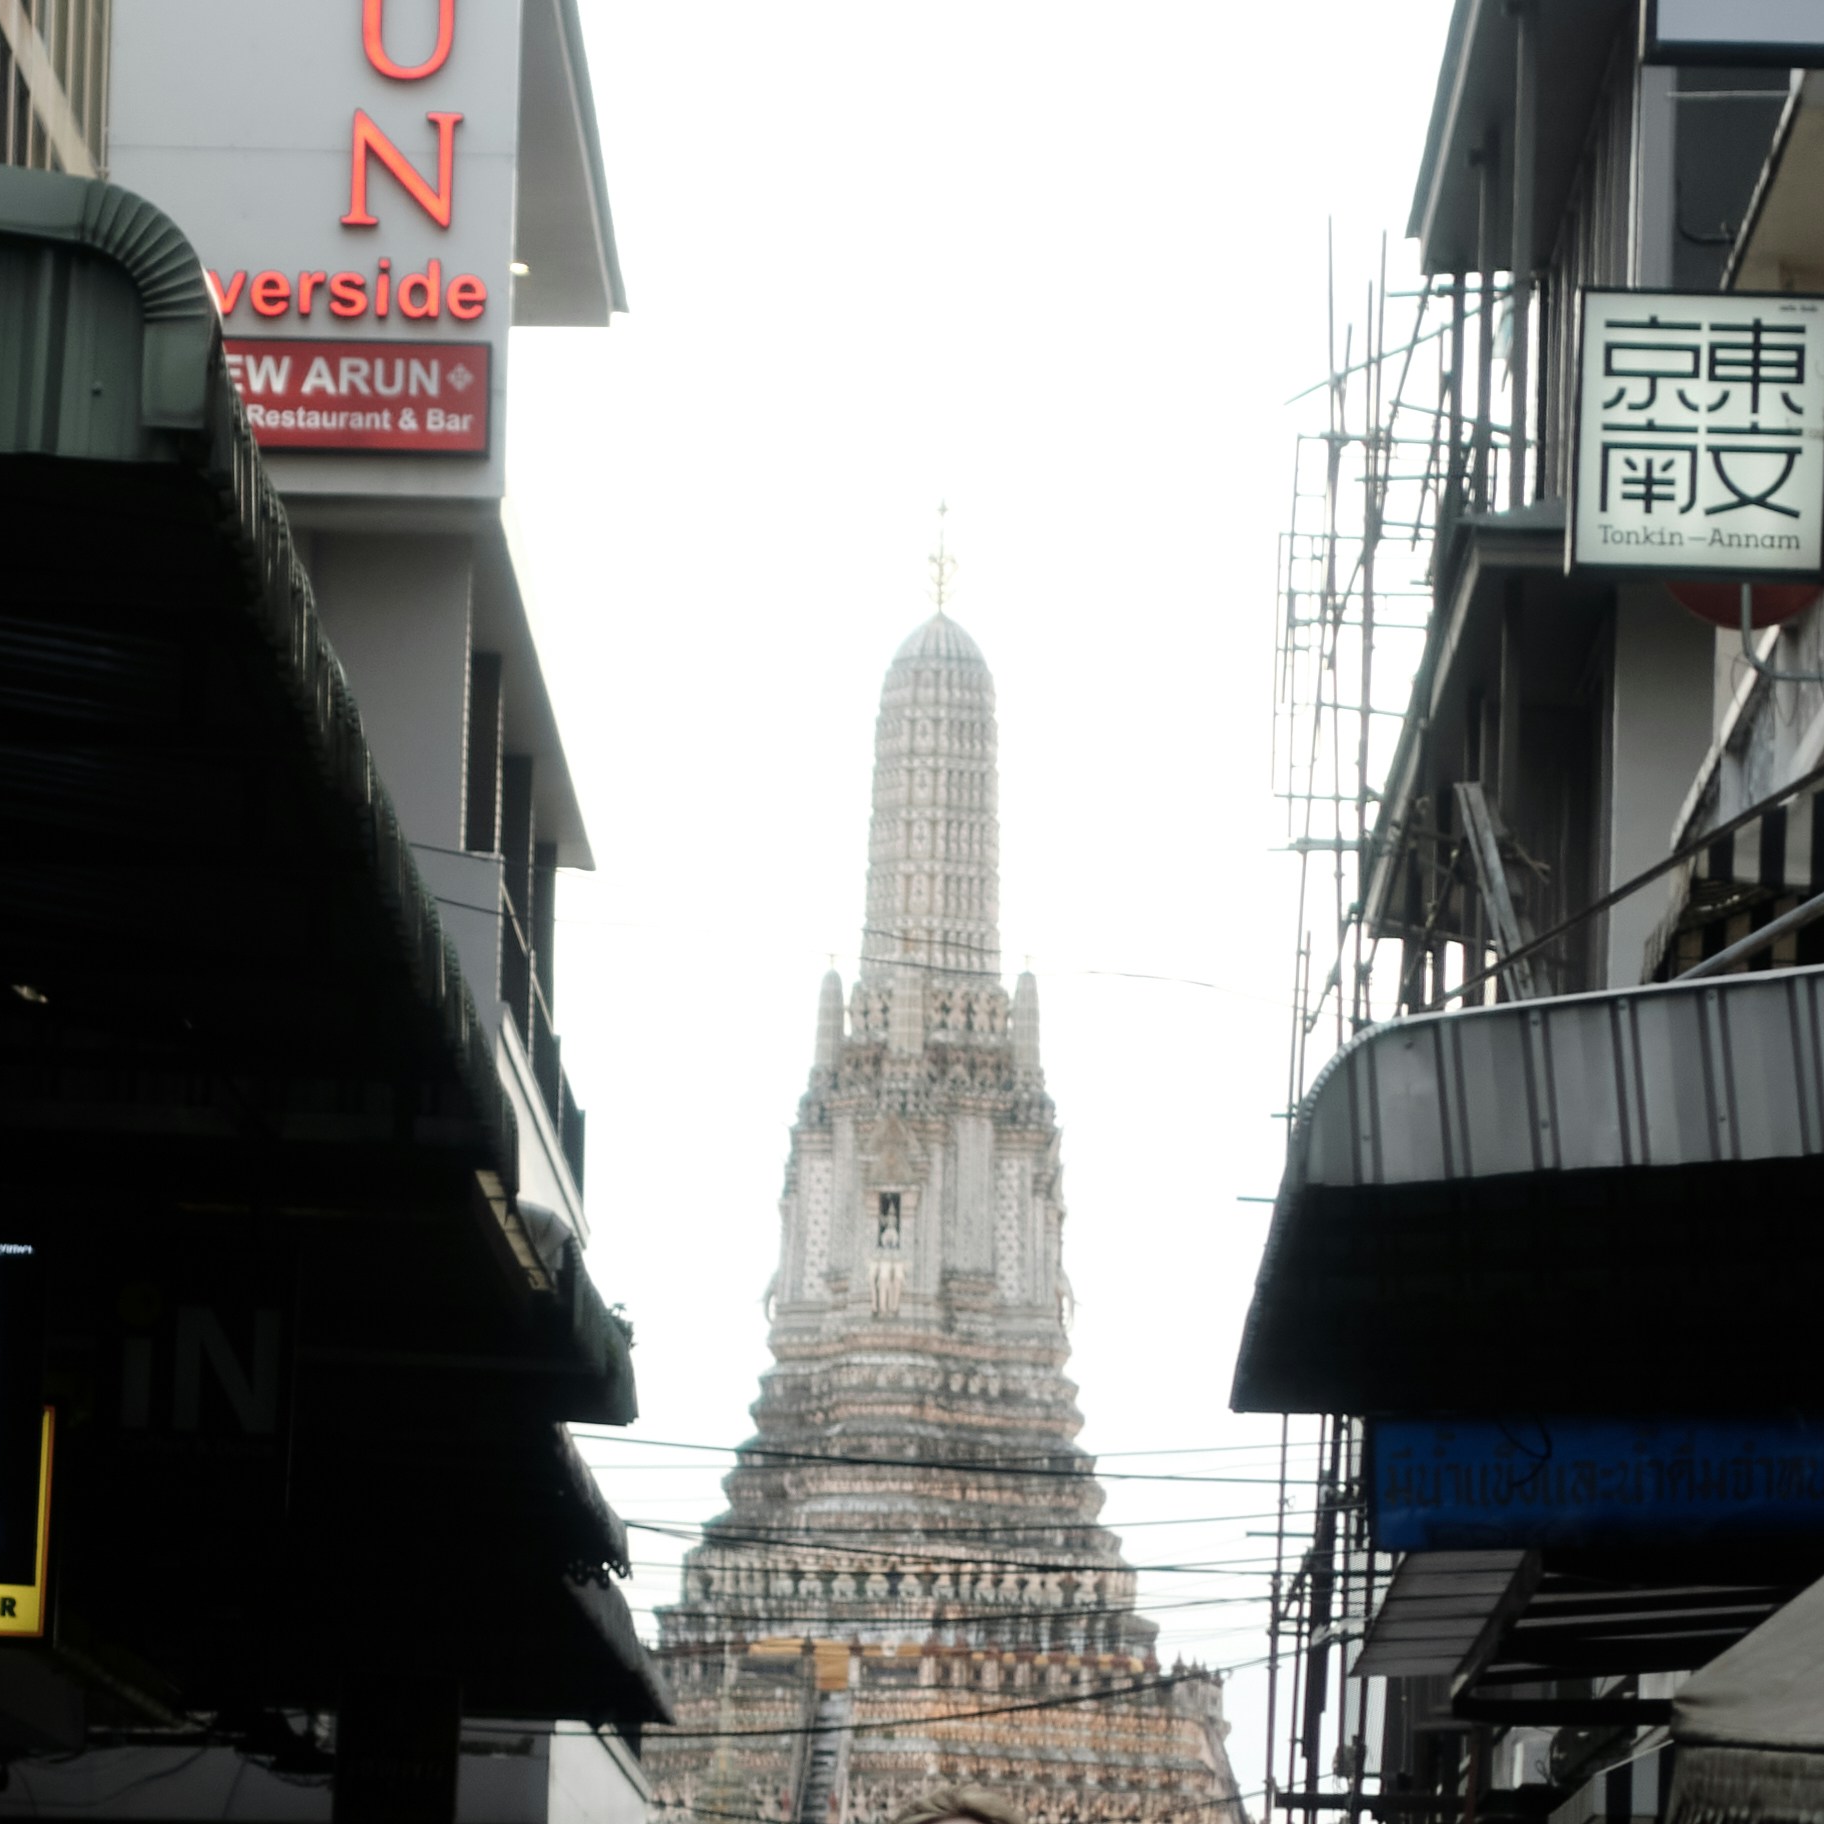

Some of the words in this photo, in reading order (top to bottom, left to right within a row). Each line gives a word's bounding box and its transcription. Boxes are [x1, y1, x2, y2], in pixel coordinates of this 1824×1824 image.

[302, 357, 441, 398] ARUN
[249, 404, 391, 432] Restaurant
[400, 407, 419, 431] &
[427, 407, 474, 433] Bar
